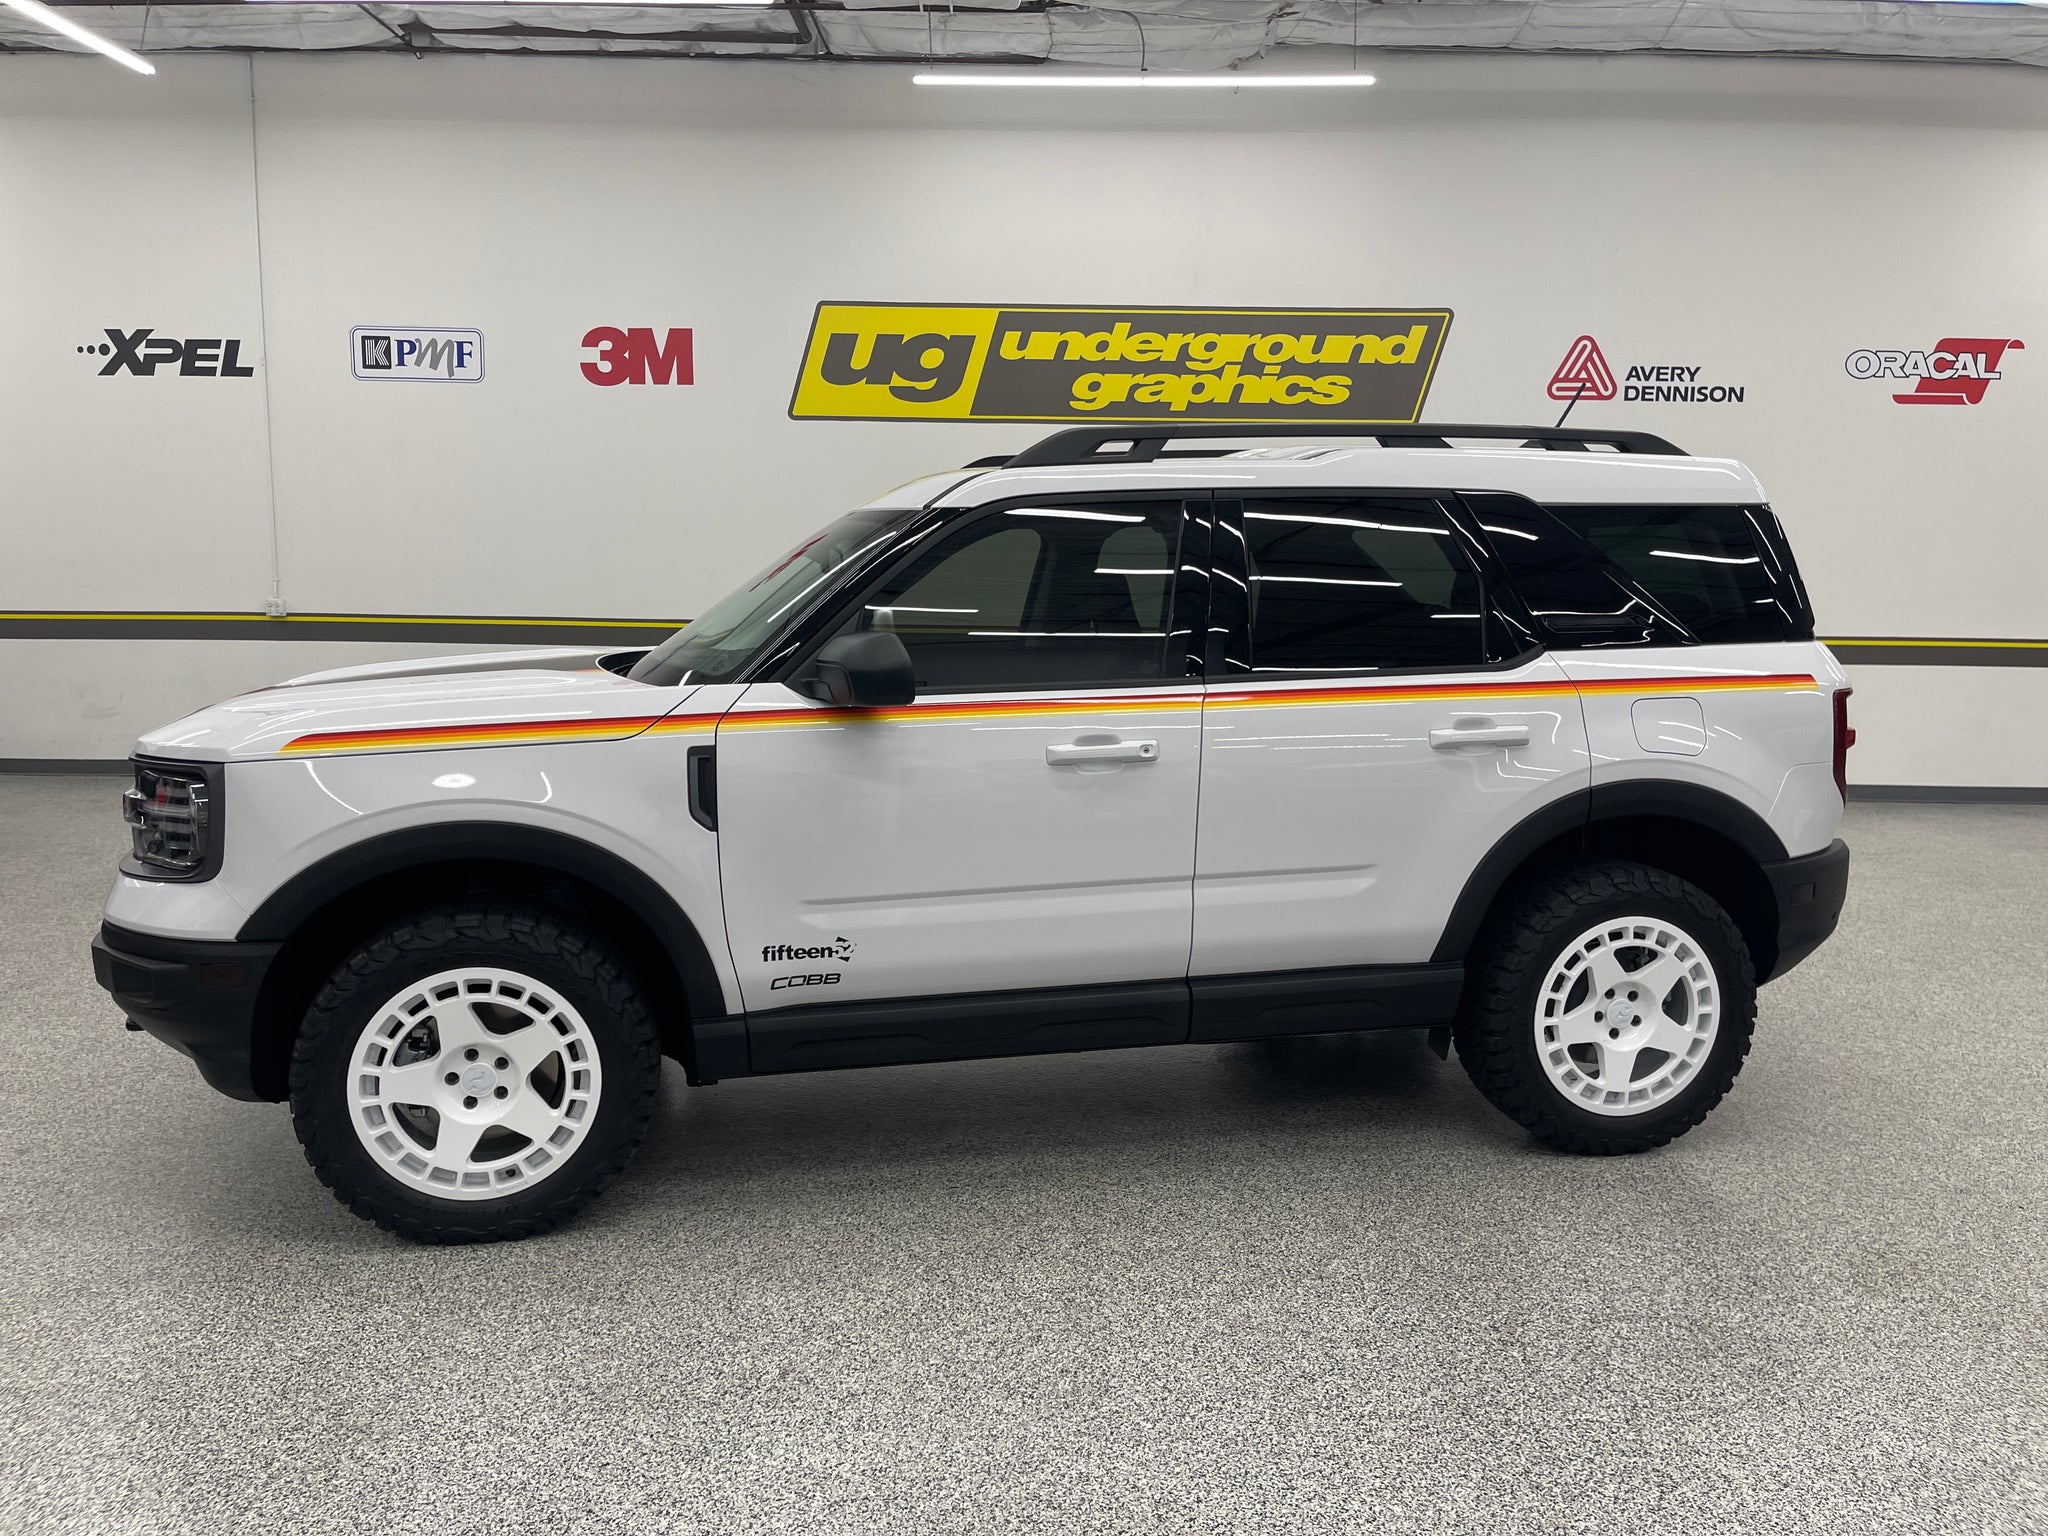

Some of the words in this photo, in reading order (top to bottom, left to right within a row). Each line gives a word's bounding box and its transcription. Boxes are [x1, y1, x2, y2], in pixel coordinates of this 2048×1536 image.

[97, 328, 254, 377] XPEL
[361, 335, 474, 378] KPMF
[580, 326, 694, 386] 3M
[820, 332, 977, 402] ug
[999, 322, 1429, 371] underground
[1845, 349, 2001, 380] ORACAL
[1069, 364, 1352, 411] graphics
[1623, 385, 1745, 403] DENNISON
[1625, 366, 1701, 383] AVERY
[770, 973, 841, 990] COBB
